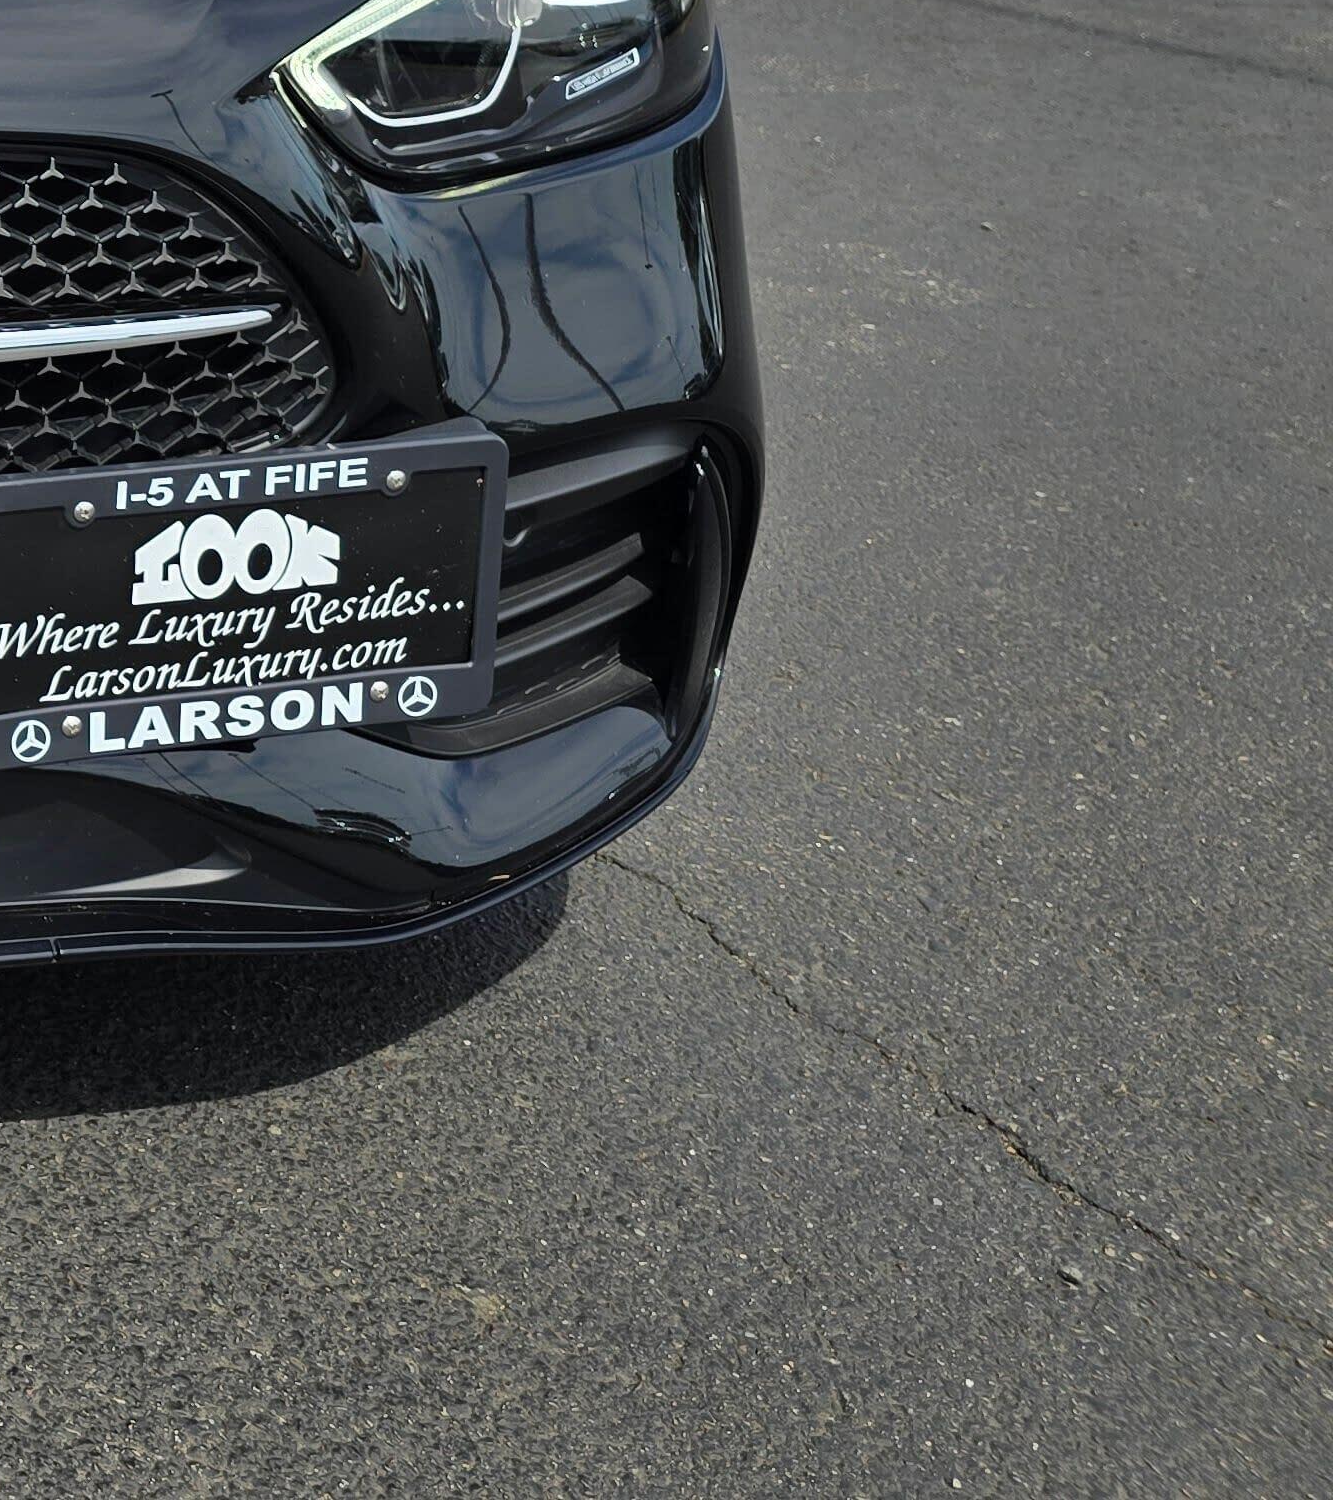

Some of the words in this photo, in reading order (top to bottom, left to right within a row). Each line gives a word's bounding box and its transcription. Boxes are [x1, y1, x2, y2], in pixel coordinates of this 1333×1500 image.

[115, 476, 174, 510] I-5
[184, 469, 251, 503] AT
[264, 457, 369, 496] FIFE
[128, 602, 278, 649] Luxury
[285, 576, 466, 634] Resides...
[39, 636, 408, 703] LarsonLuxury.com
[88, 681, 364, 754] LARSON
